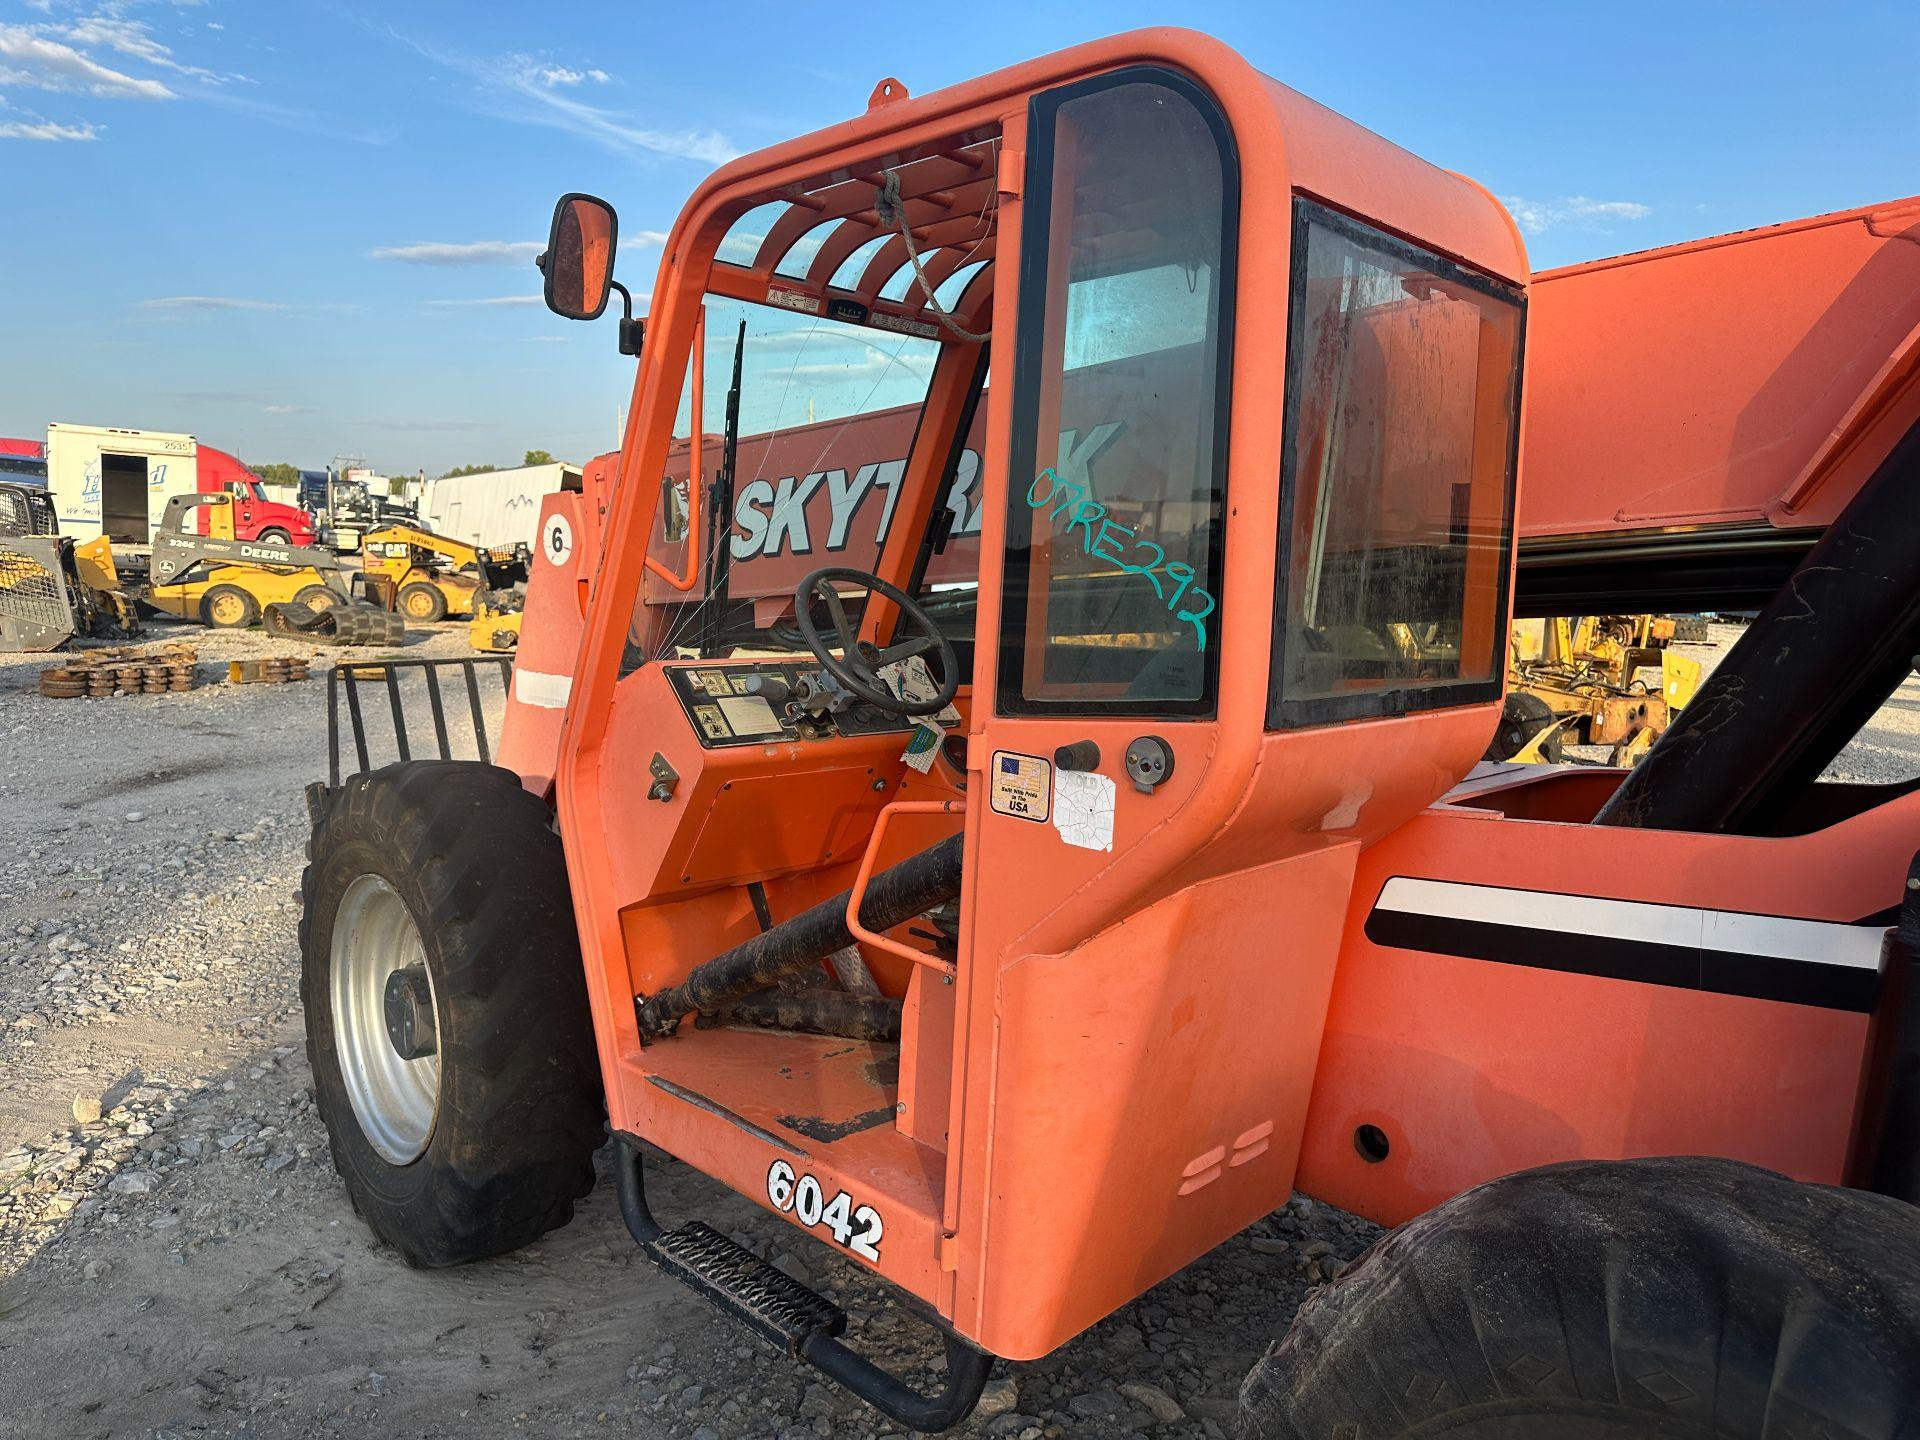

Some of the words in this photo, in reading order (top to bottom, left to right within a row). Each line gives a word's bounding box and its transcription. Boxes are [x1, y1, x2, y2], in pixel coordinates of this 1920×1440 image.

[552, 526, 563, 552] 6
[240, 545, 290, 561] DEERE
[385, 543, 408, 558] CAT
[1009, 800, 1029, 814] USA
[767, 1159, 883, 1263] 6042
